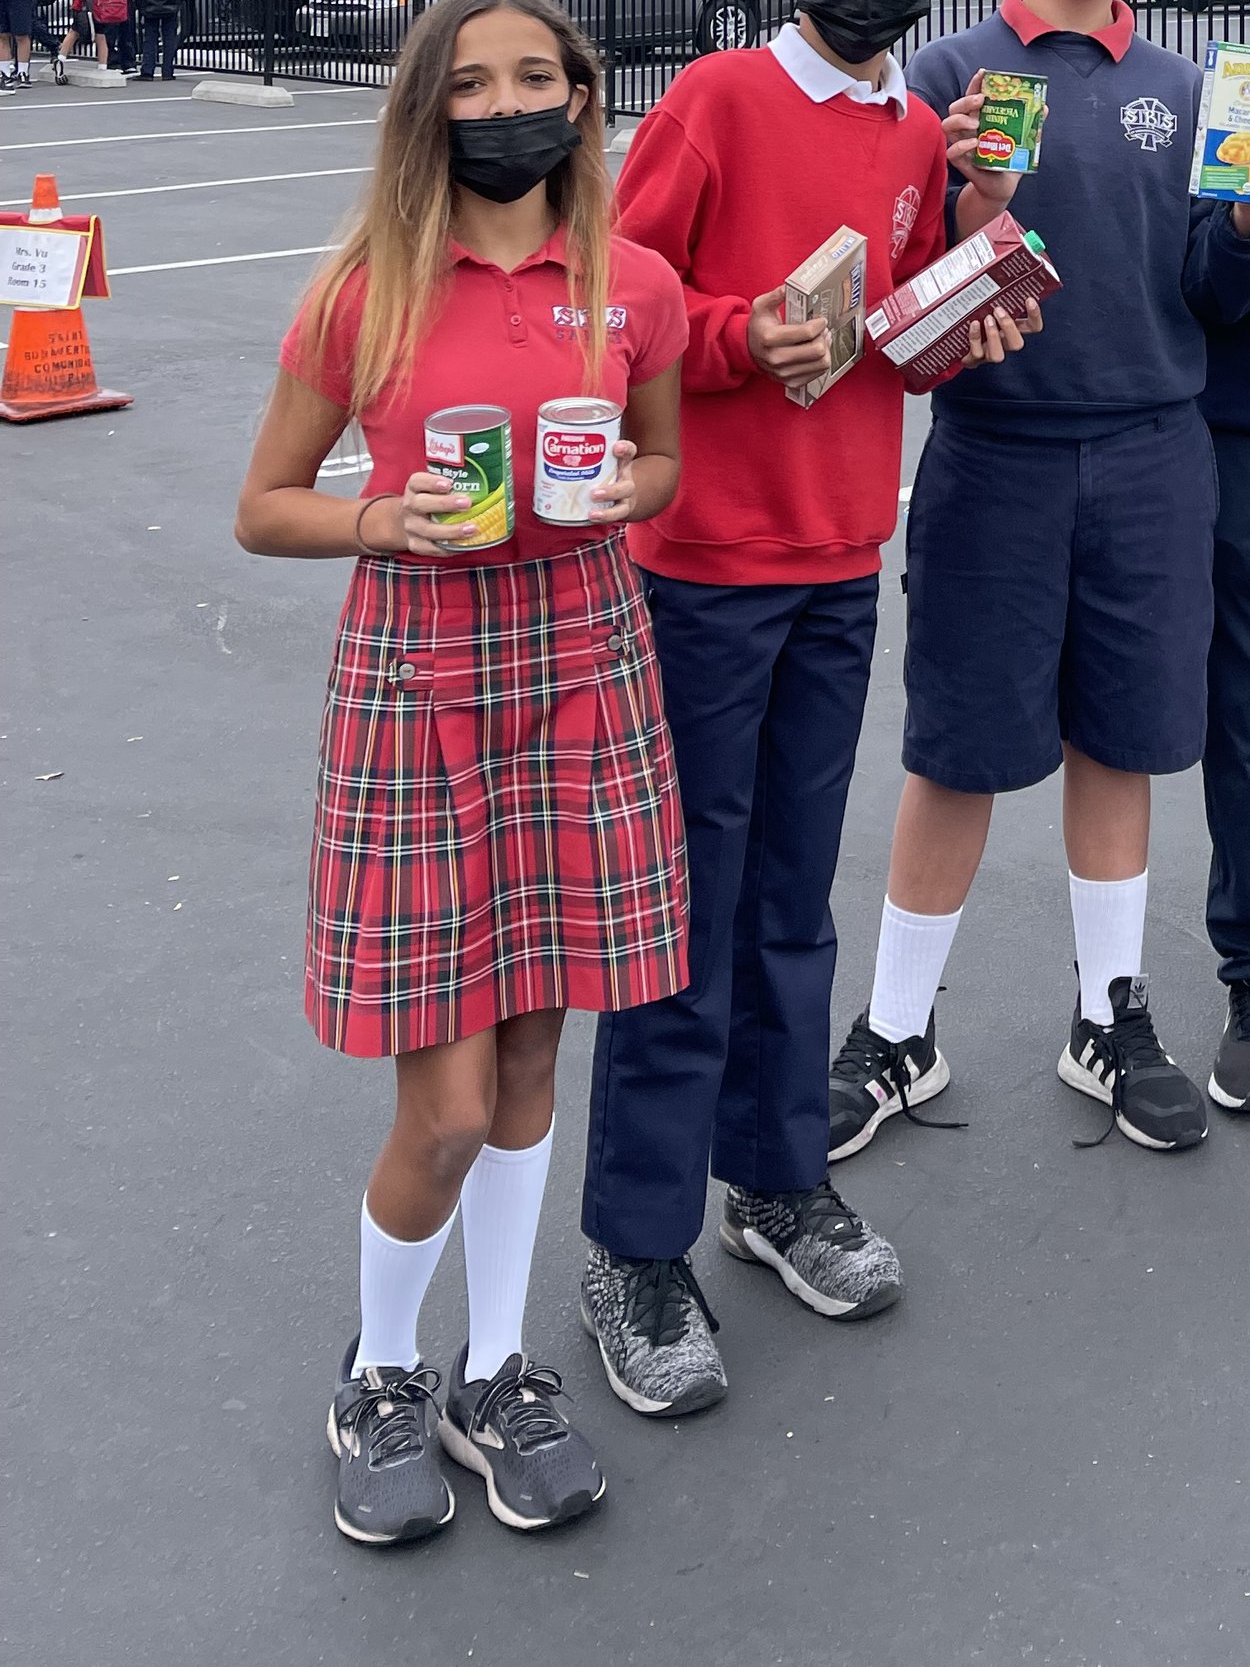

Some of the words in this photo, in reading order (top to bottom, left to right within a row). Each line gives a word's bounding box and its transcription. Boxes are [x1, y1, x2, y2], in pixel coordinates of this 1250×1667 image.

[15, 247, 32, 257] Mrs.
[35, 248, 48, 258] Vu
[11, 262, 36, 273] Grade
[39, 264, 46, 273] 3
[7, 276, 29, 287] Room
[33, 278, 47, 289] 15
[544, 436, 605, 457] Carnation
[442, 467, 469, 478] Style
[452, 481, 480, 492] orn
